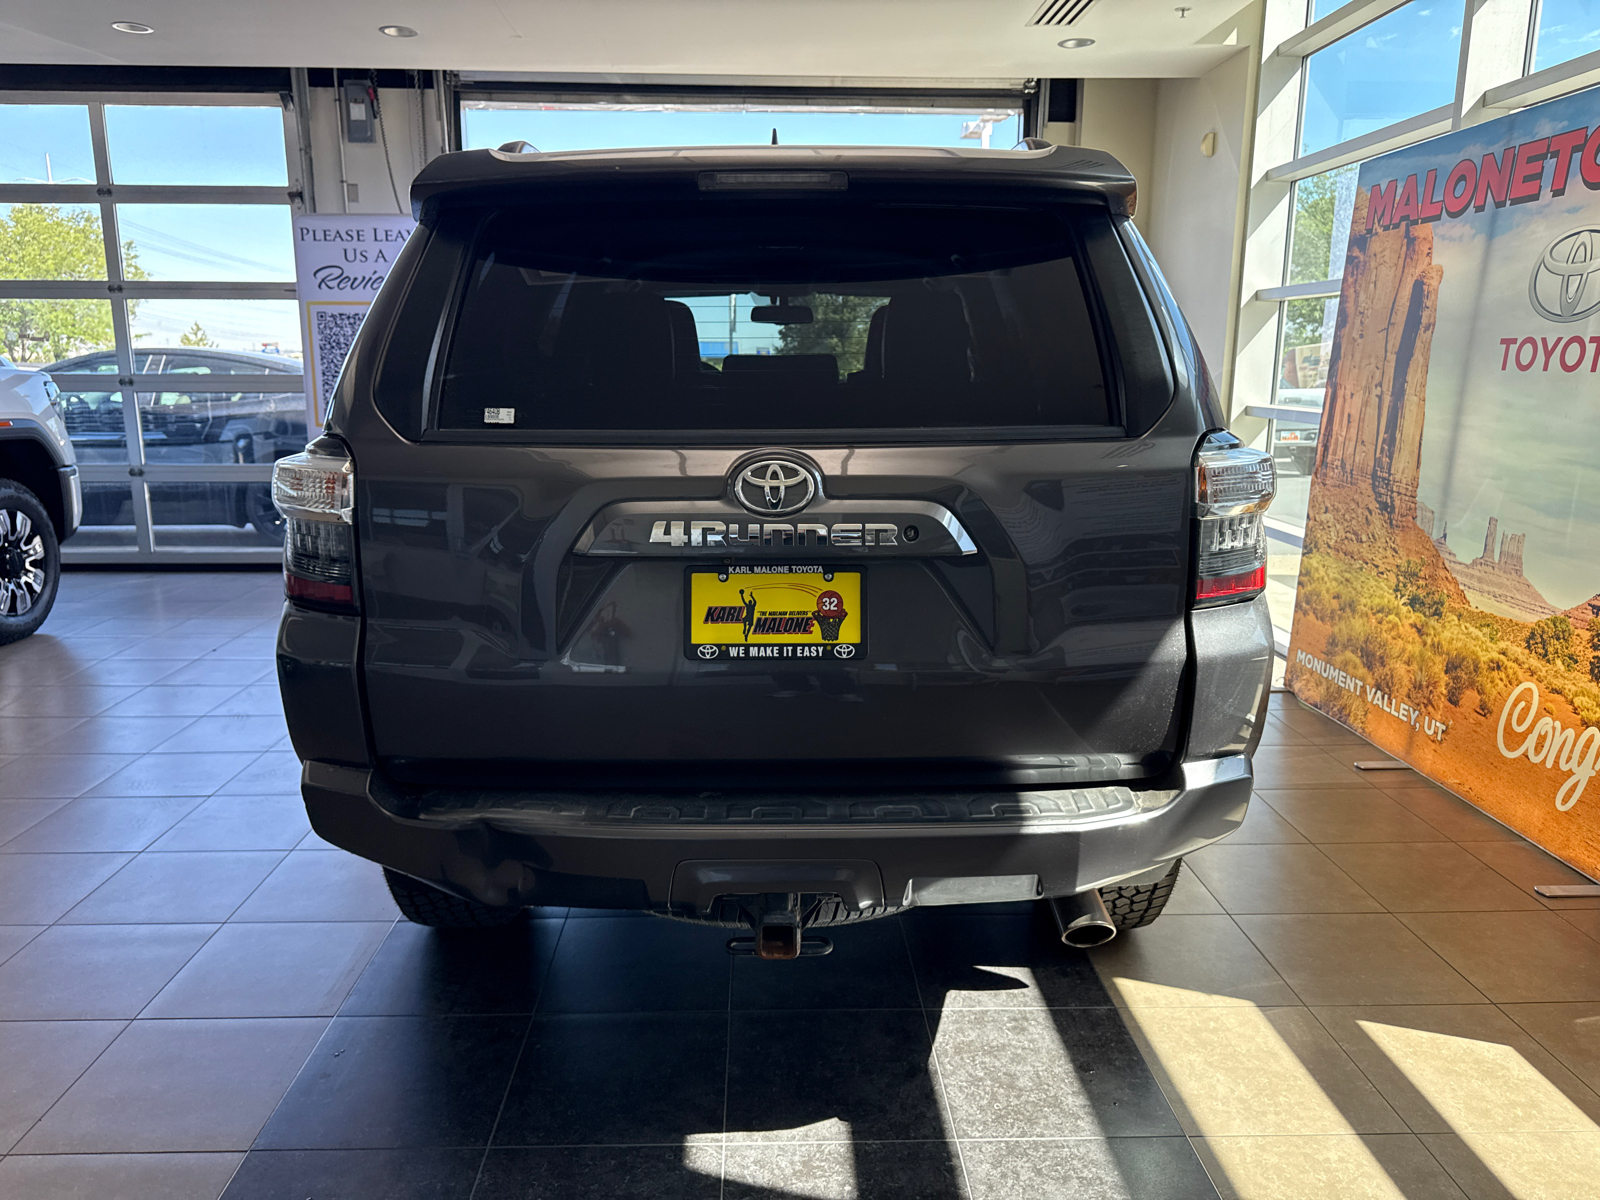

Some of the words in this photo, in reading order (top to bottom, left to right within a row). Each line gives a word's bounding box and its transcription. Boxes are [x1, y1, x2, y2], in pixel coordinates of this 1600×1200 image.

[299, 227, 366, 242] PLEASE
[373, 227, 412, 242] LEA
[343, 248, 368, 263] US
[374, 249, 389, 263] A
[313, 265, 385, 291] Revie
[649, 520, 899, 547] 4RUNNER
[729, 565, 752, 574] KARL
[753, 565, 790, 574] MALONE
[792, 565, 824, 574] TOYOTA
[822, 597, 838, 611] 32
[703, 606, 746, 625] KARL
[752, 617, 814, 635] MALONE
[729, 646, 745, 657] WE
[750, 646, 780, 657] MAKE
[783, 646, 793, 657] IT
[797, 646, 824, 657] EASY
[1296, 648, 1364, 697] MONUMENT
[1366, 684, 1421, 732] VALLEY,
[1423, 715, 1447, 742] UT
[1497, 681, 1600, 812] Cong
